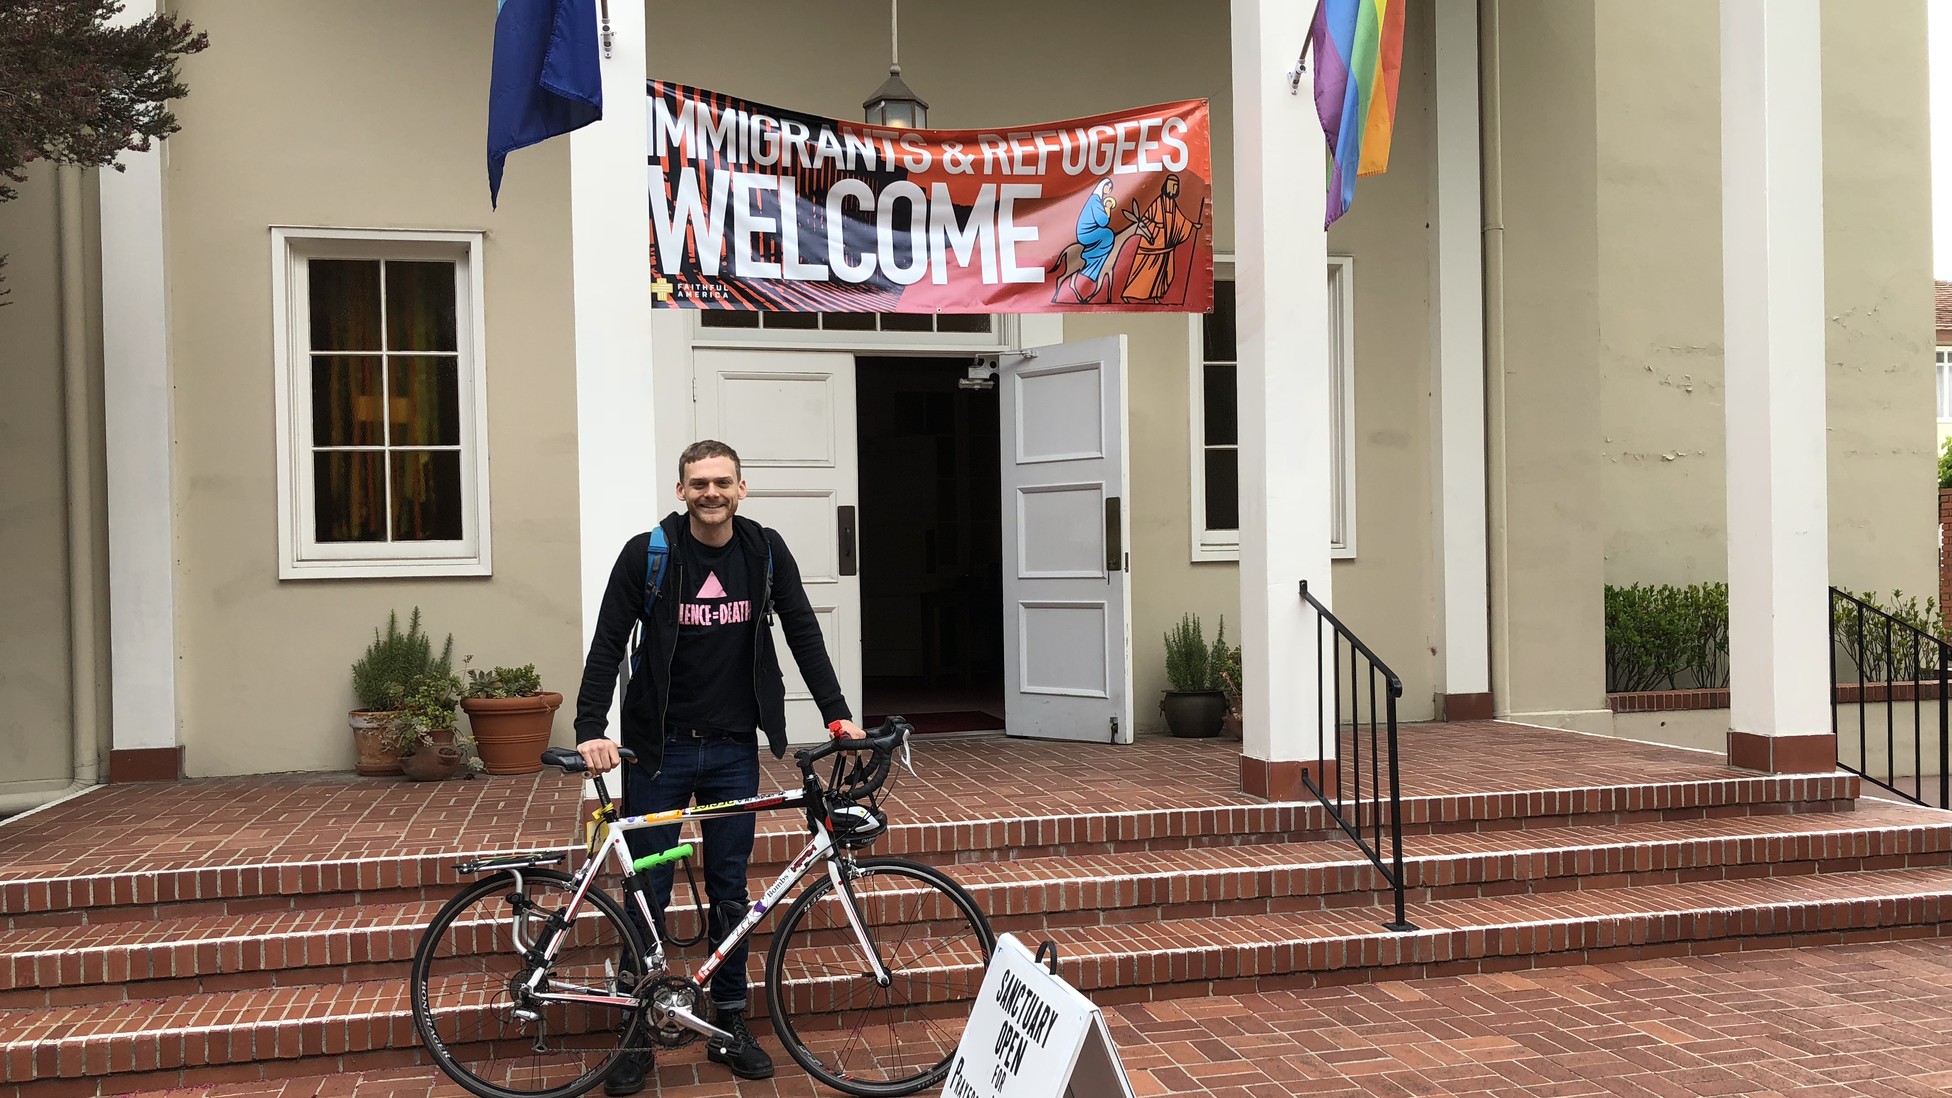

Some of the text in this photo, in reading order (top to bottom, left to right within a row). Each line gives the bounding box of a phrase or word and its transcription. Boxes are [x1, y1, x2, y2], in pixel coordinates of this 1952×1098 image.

[647, 96, 1189, 175] IMMIGRANTS & REFUGEES
[647, 165, 1046, 286] WELCOME
[677, 283, 729, 292] FAITHFUL
[677, 290, 729, 299] AMERICA
[679, 600, 752, 626] LENCE=DEATH
[766, 875, 789, 898] Bombs
[421, 980, 451, 1059] BONTRAGER
[995, 968, 1059, 1049] SANCTUARY
[994, 1019, 1029, 1077] OPEN
[990, 1064, 1007, 1094] FOR
